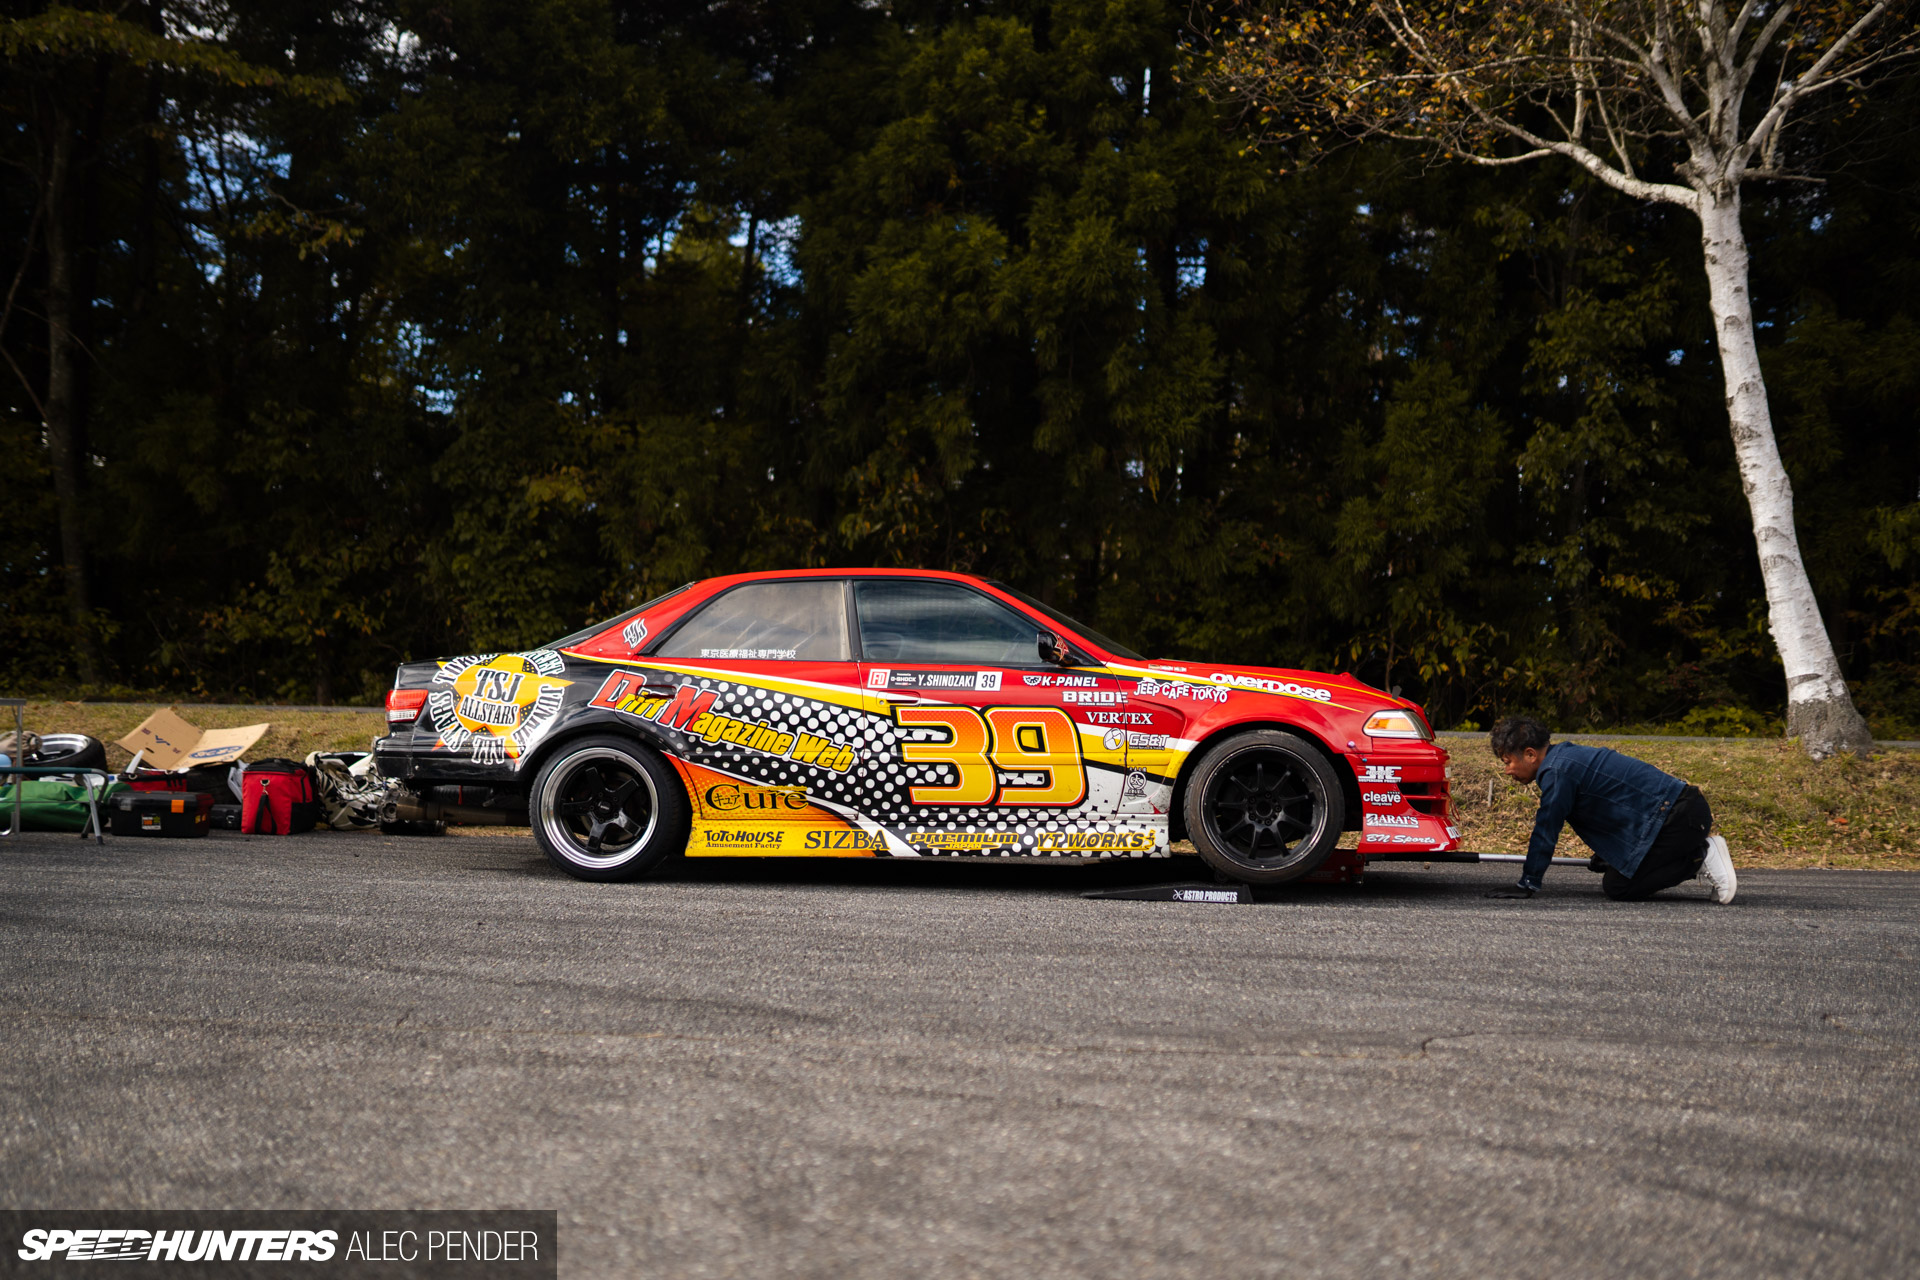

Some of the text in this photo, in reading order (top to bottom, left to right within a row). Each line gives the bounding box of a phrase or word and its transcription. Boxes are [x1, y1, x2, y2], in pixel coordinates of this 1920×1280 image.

[473, 667, 525, 704] TSJ
[918, 674, 976, 688] Y.SHINOZAKI
[980, 674, 997, 689] 39
[1041, 675, 1099, 688] K-PANEL
[1062, 691, 1129, 704] BRIDE
[1134, 683, 1228, 703] JEEP CAFE TOKYO
[458, 695, 521, 725] ALLSTARS
[1085, 711, 1154, 726] VERTEX
[428, 690, 472, 753] STARS
[656, 684, 798, 757] Magazine
[789, 731, 858, 774] Web
[893, 707, 1086, 806] 39
[704, 784, 809, 811] Cure
[1362, 790, 1402, 804] cleave
[804, 830, 890, 851] SIZBA
[1038, 832, 1145, 849] YT WORKS
[1391, 834, 1436, 845] Sports
[1183, 890, 1238, 902] ASTRO PRODUCTS
